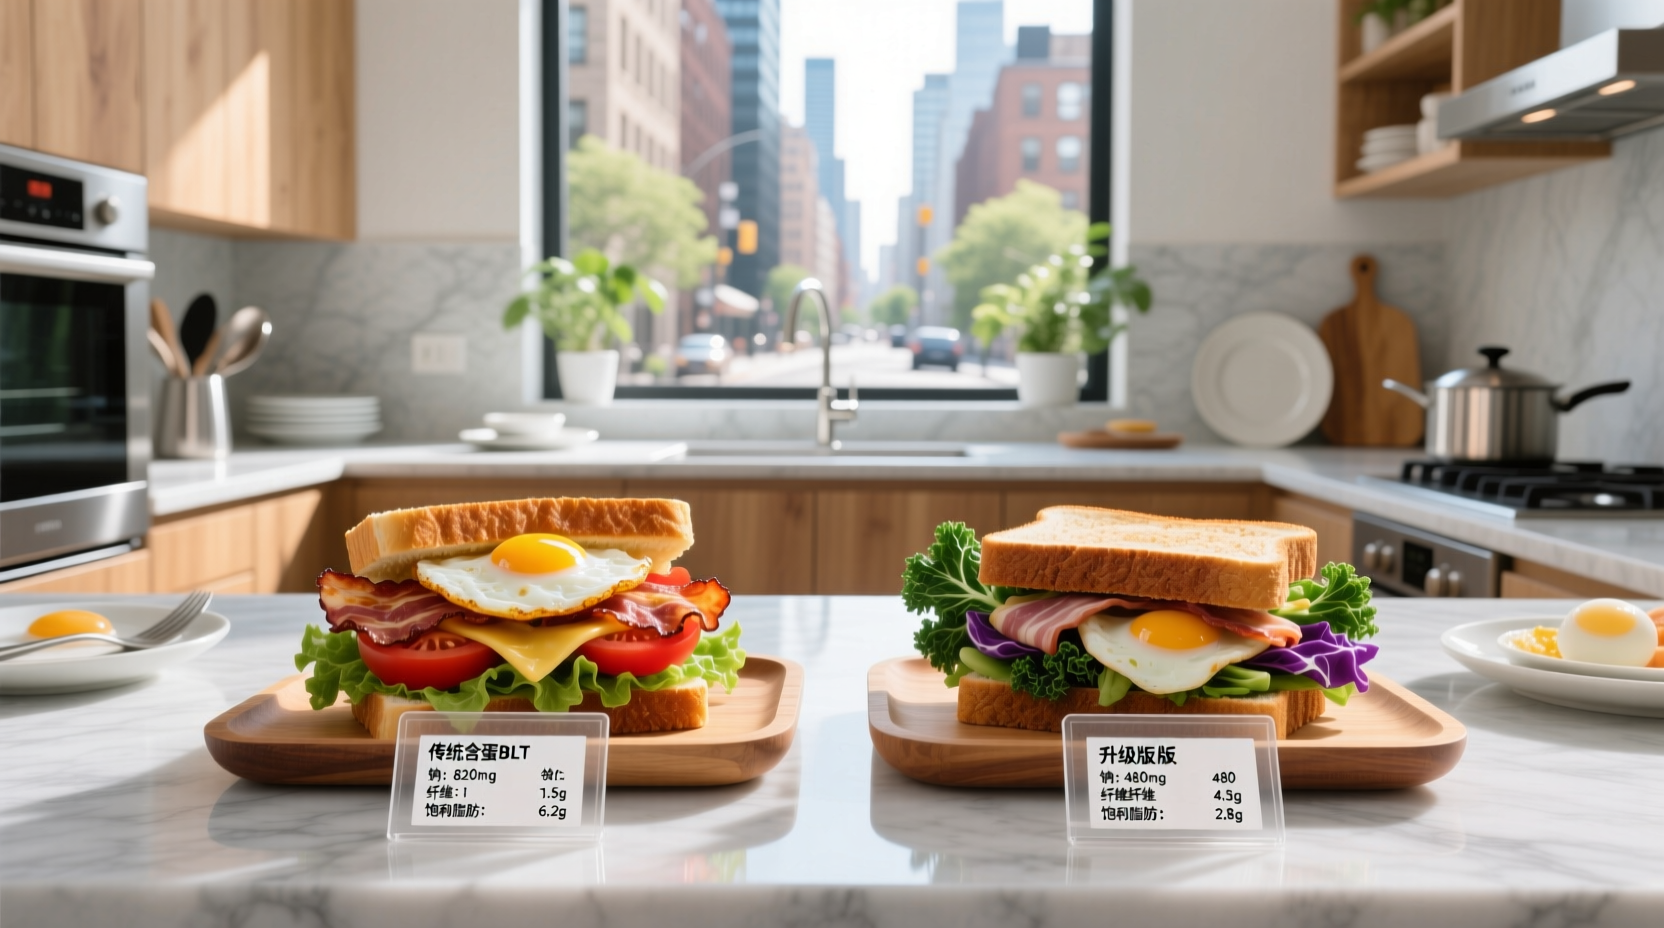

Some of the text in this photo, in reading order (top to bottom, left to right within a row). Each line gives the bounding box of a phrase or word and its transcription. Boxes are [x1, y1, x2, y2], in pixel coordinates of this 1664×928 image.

[1098, 744, 1178, 766] 升级版版
[453, 768, 497, 784] 820mg
[1123, 770, 1167, 787] 480mg
[1211, 771, 1236, 784] 480
[539, 786, 567, 802] 1.5g
[1213, 789, 1242, 805] 4.5g
[538, 804, 567, 821] 6.2g
[1215, 807, 1243, 824] 2.8g
